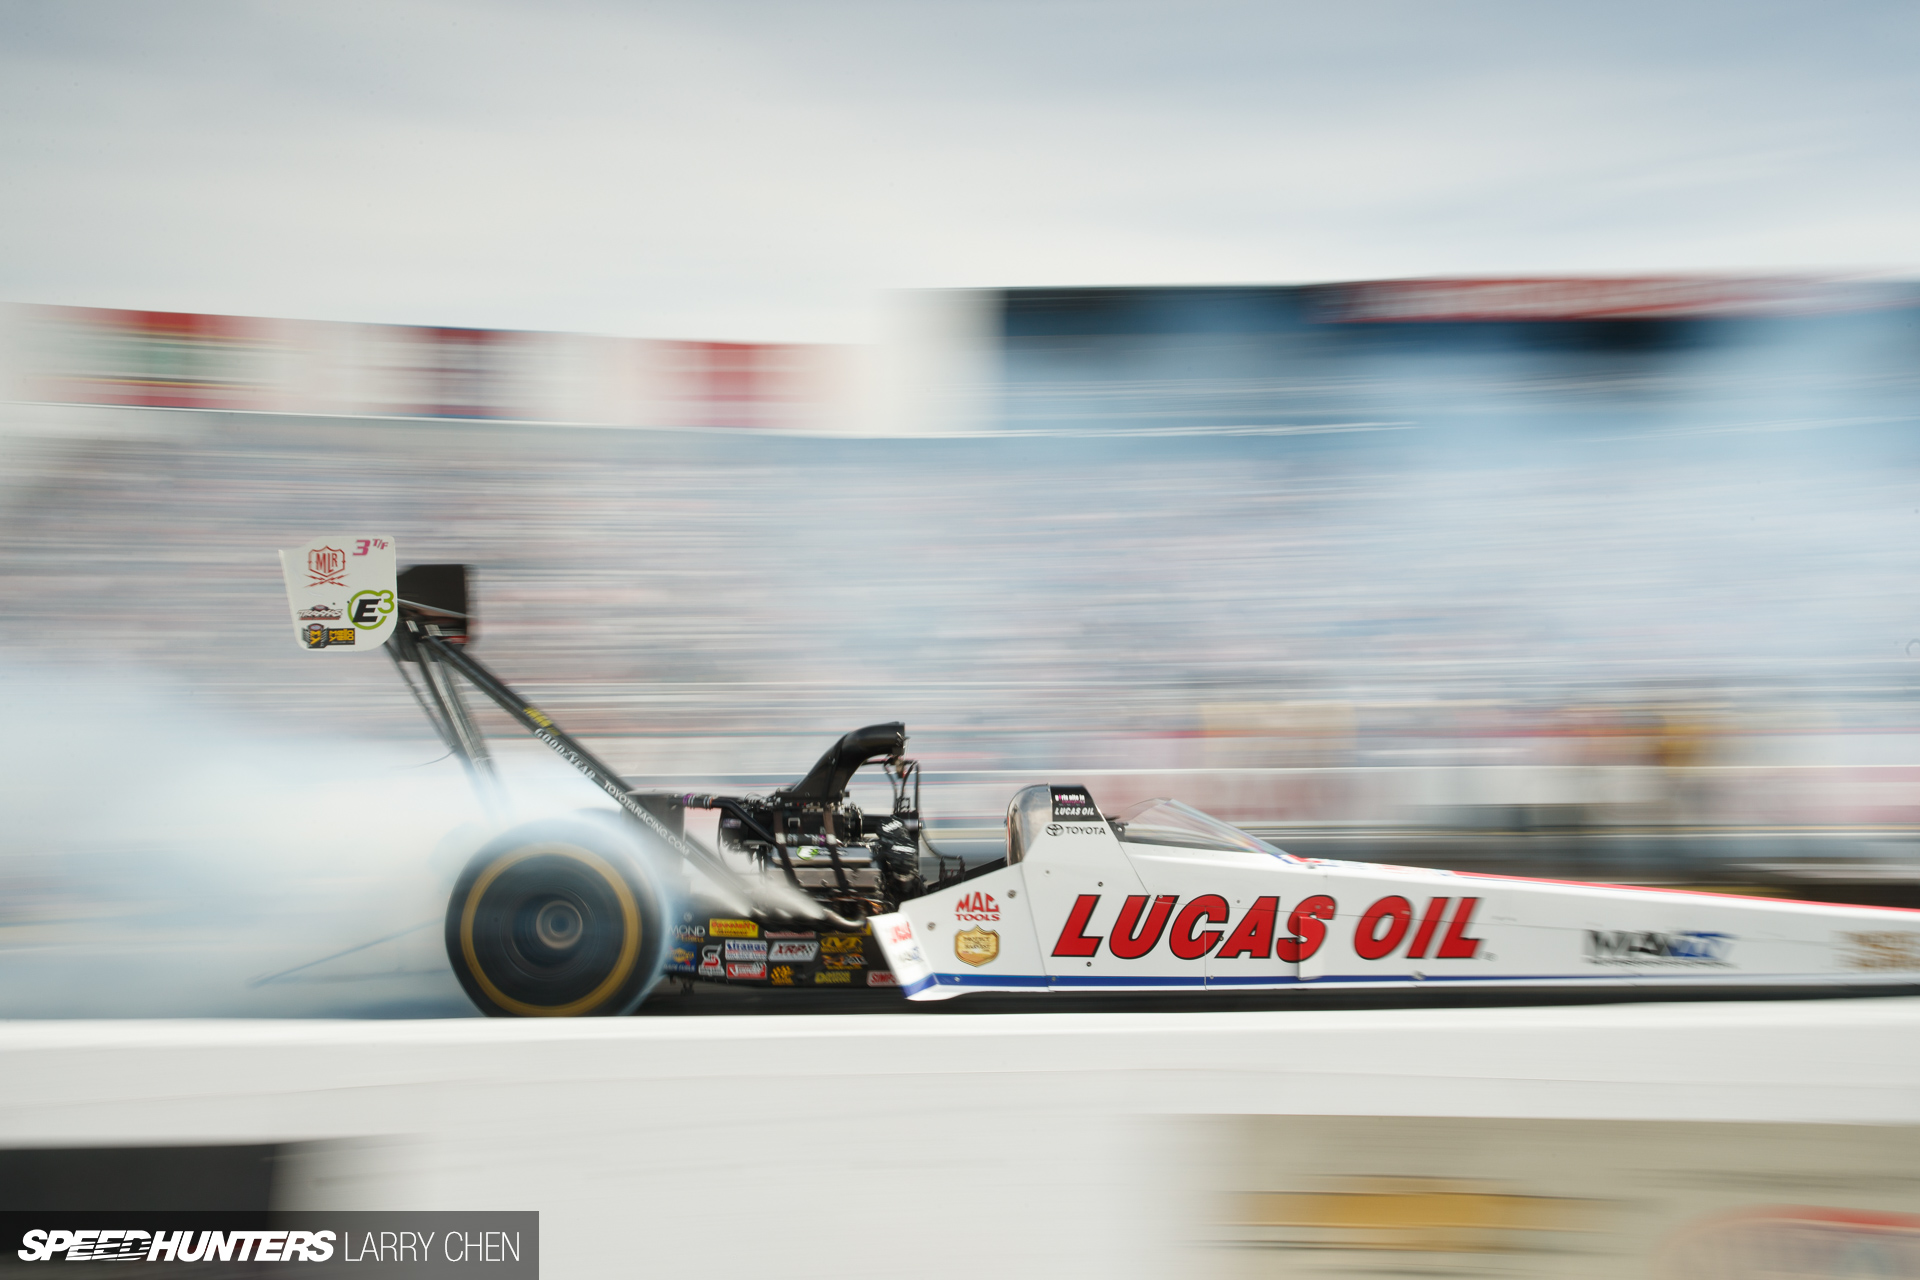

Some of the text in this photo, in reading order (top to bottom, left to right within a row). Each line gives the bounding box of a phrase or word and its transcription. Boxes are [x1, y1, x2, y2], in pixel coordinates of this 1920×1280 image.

[352, 539, 371, 557] 3
[315, 552, 338, 574] MLR
[534, 728, 596, 780] GOODYEAR
[603, 780, 690, 855] TOYOTARACING.COM
[1054, 807, 1095, 816] LUCAS OIL
[1066, 826, 1106, 835] TOYOTA
[956, 891, 1000, 913] MAC
[1051, 894, 1487, 963] LUCAS OIL
